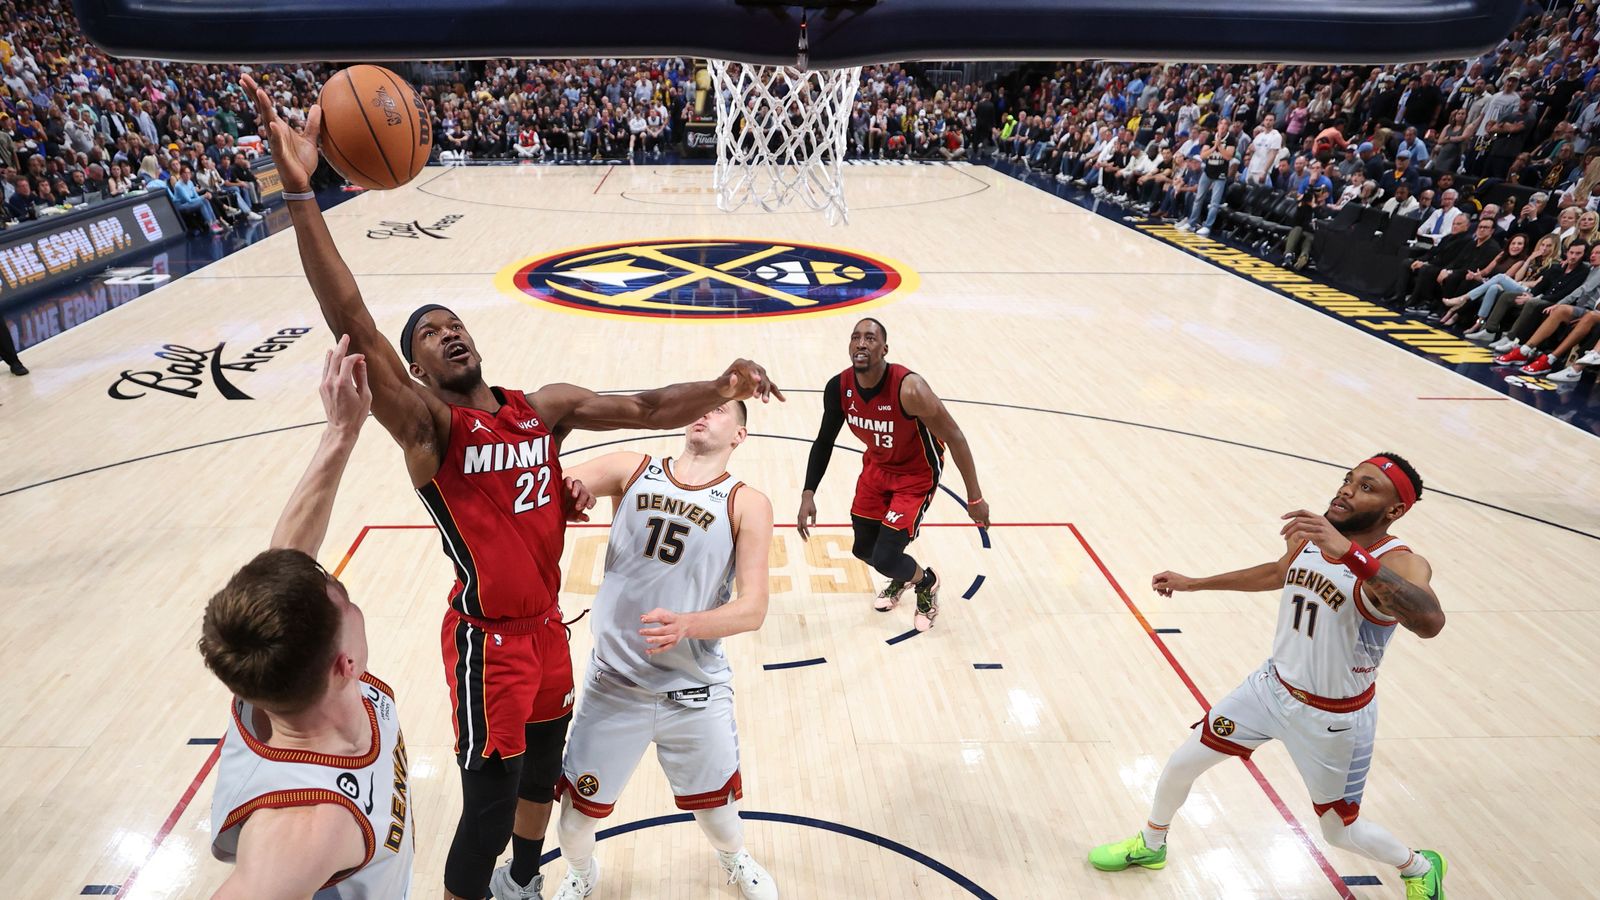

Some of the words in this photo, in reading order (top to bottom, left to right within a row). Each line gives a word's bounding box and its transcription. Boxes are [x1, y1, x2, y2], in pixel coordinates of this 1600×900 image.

[0, 242, 46, 289] THE
[37, 226, 95, 274] ESPN
[1272, 283, 1401, 317] HIGH
[1356, 319, 1496, 364] MILE
[108, 343, 227, 400] Ball
[220, 327, 312, 373] Arena
[846, 389, 853, 398] 6
[847, 413, 894, 433] MIAMI
[873, 433, 893, 448] 13
[464, 434, 551, 475] MIAMI
[514, 465, 552, 515] 22
[636, 493, 717, 532] DENVER
[643, 516, 692, 566] 15
[1286, 567, 1347, 613] DENVER
[1292, 593, 1320, 640] 11
[339, 776, 358, 799] 6
